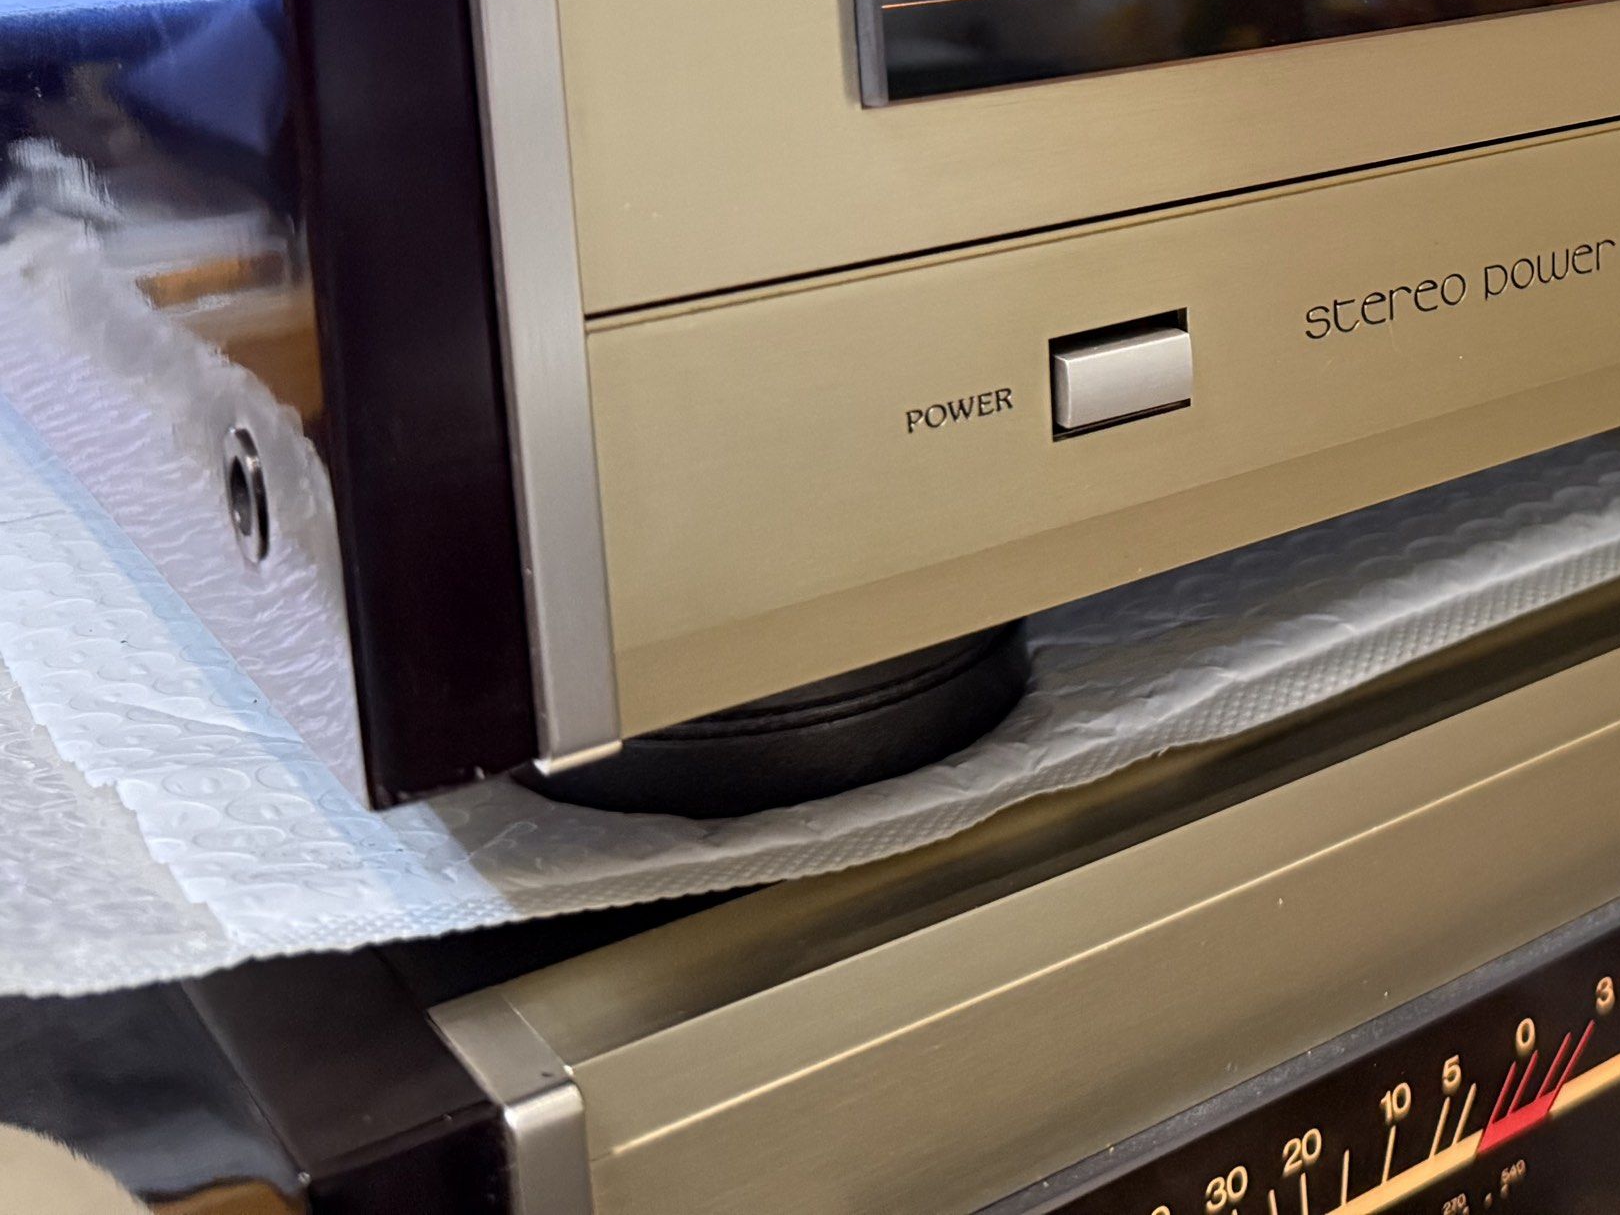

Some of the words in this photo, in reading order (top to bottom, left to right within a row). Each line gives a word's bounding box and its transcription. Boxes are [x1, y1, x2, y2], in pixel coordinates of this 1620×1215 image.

[1305, 272, 1467, 340] stereo
[1484, 237, 1615, 300] power
[905, 387, 1013, 434] POWER
[1205, 1165, 1249, 1213] 30
[1283, 1128, 1322, 1179] 20
[1379, 1082, 1412, 1124] 10
[1442, 1054, 1462, 1096] 5
[1515, 1018, 1535, 1057] 0
[1596, 977, 1616, 1016] 3
